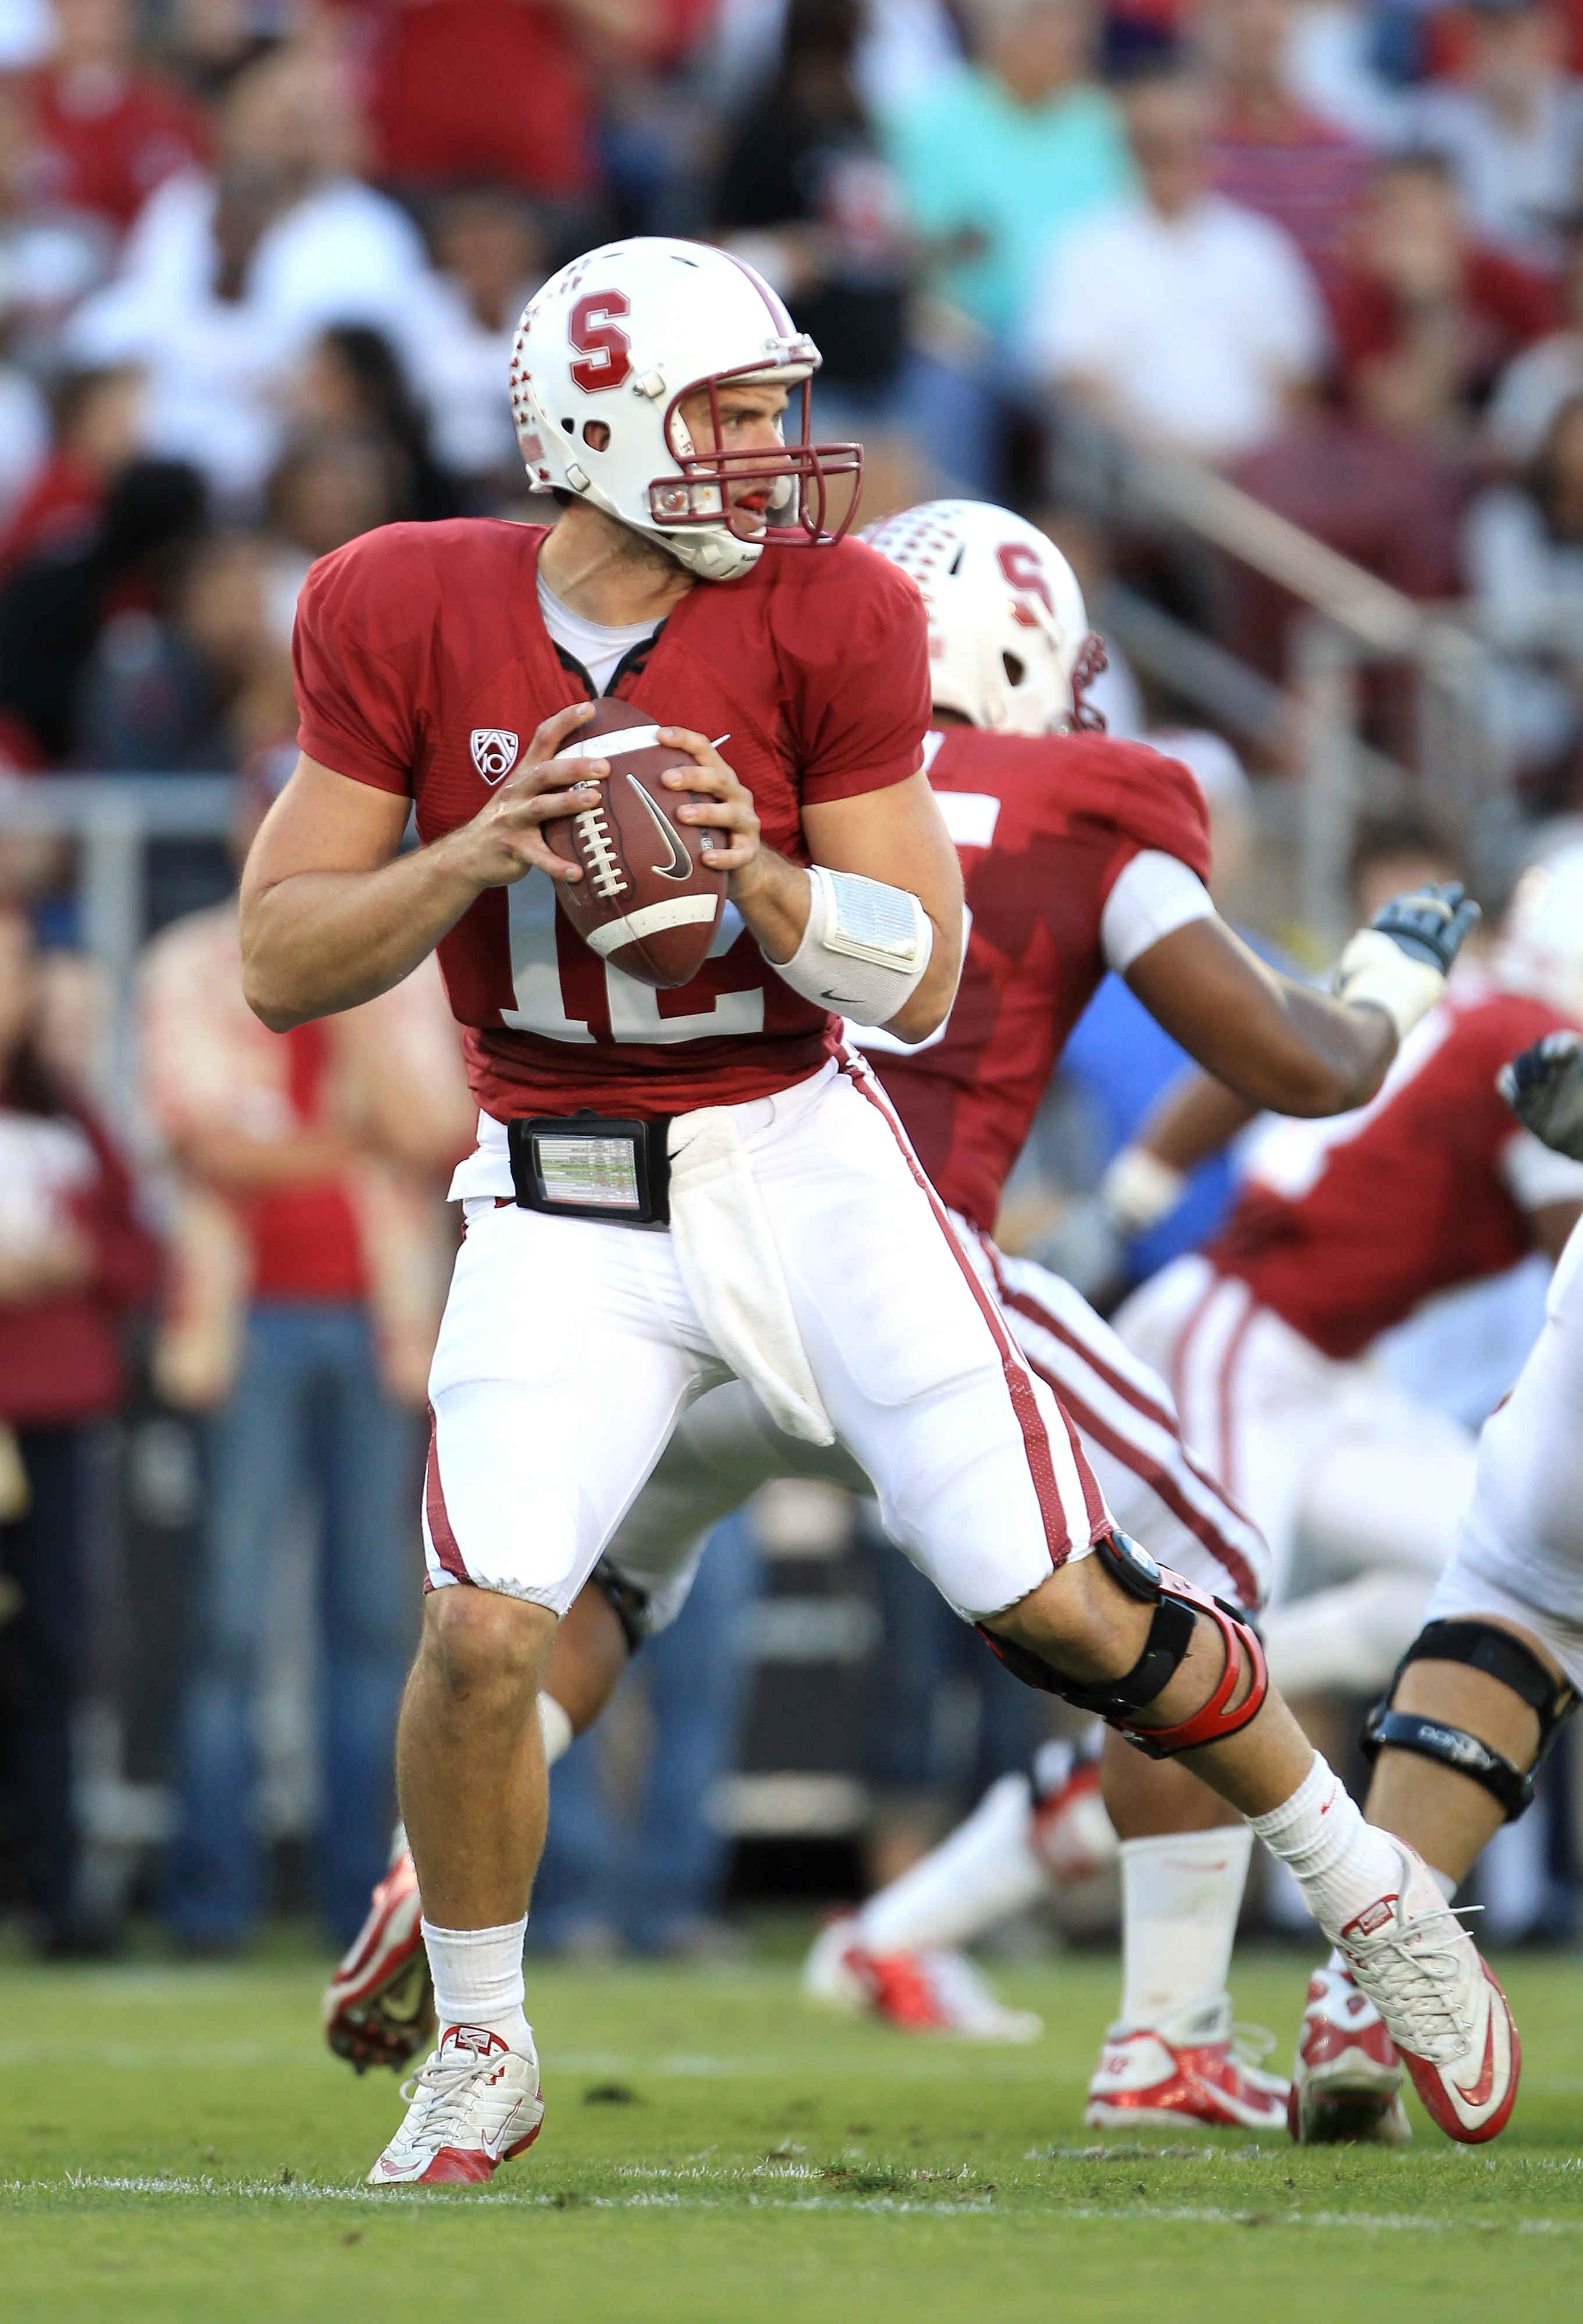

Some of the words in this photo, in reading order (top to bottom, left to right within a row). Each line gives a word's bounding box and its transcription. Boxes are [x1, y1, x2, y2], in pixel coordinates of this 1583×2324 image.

[568, 288, 632, 394] S
[996, 541, 1055, 626] S
[474, 731, 516, 764] PAC
[482, 752, 507, 774] 10
[499, 864, 764, 1044] 12
